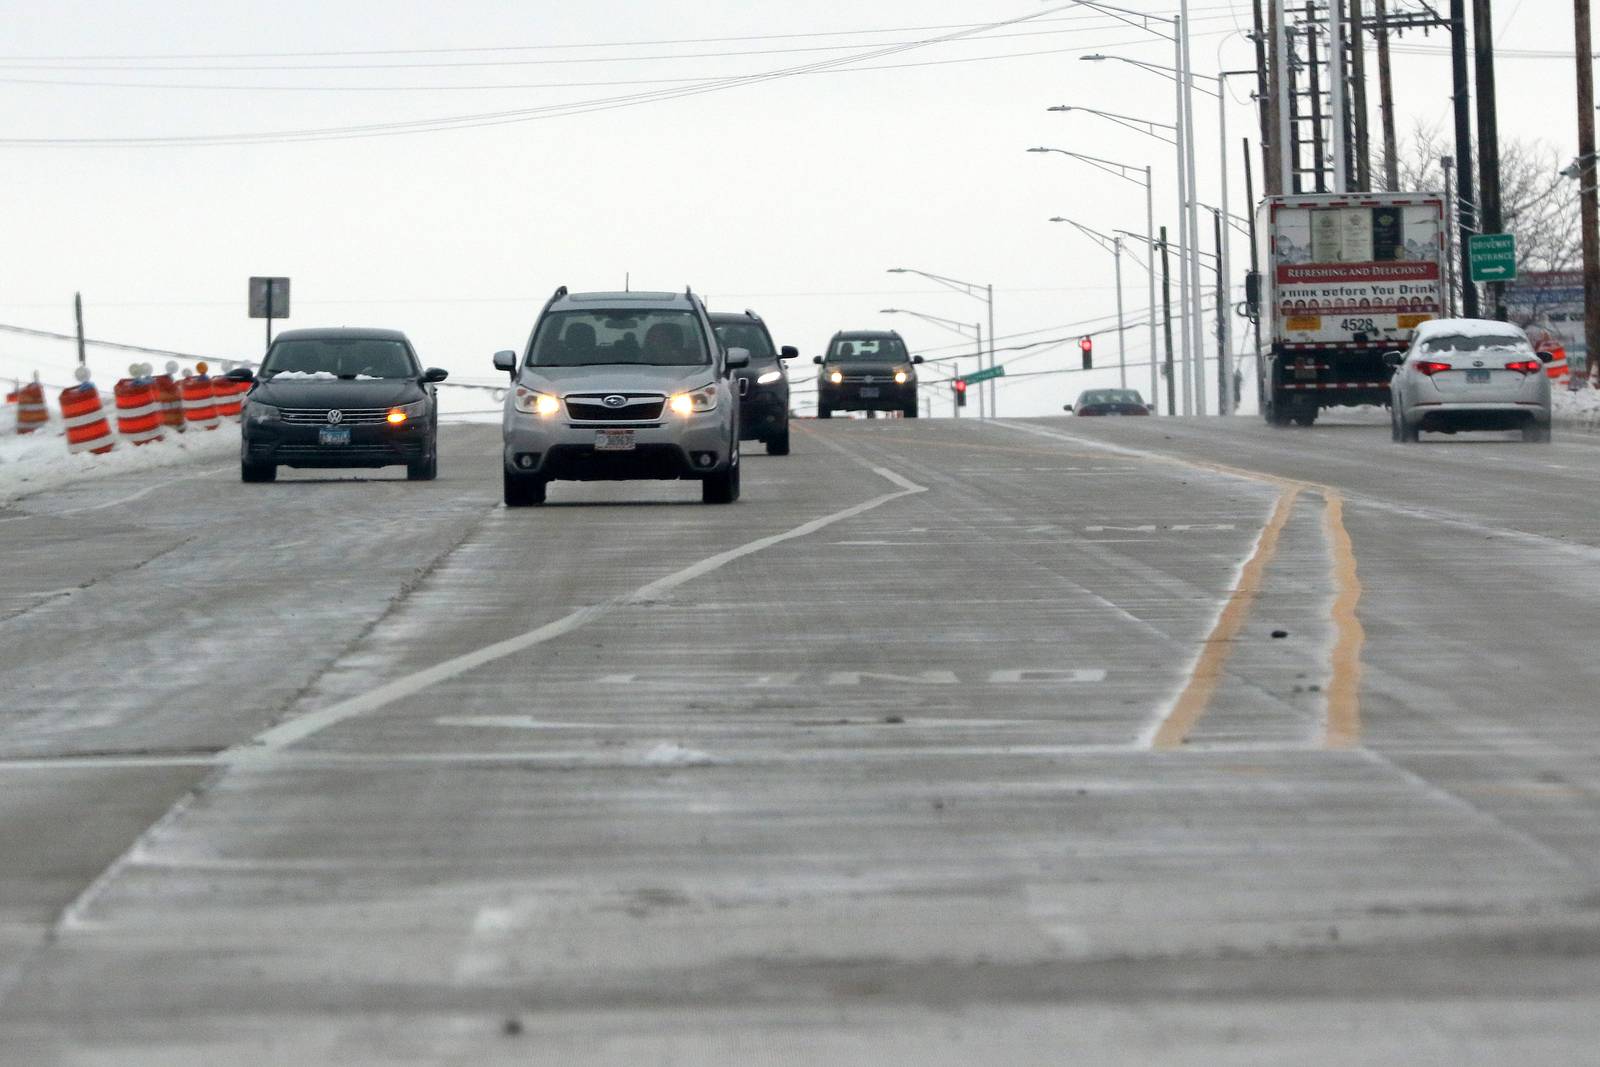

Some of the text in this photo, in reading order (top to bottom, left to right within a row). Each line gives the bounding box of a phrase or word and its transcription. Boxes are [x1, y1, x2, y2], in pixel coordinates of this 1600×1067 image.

[1472, 252, 1512, 262] ENTRANCE
[1287, 268, 1346, 278] REFRESHING
[1349, 267, 1369, 276] AND
[1371, 285, 1394, 295] You
[1399, 284, 1435, 294] Drink
[1340, 318, 1373, 332] 4528
